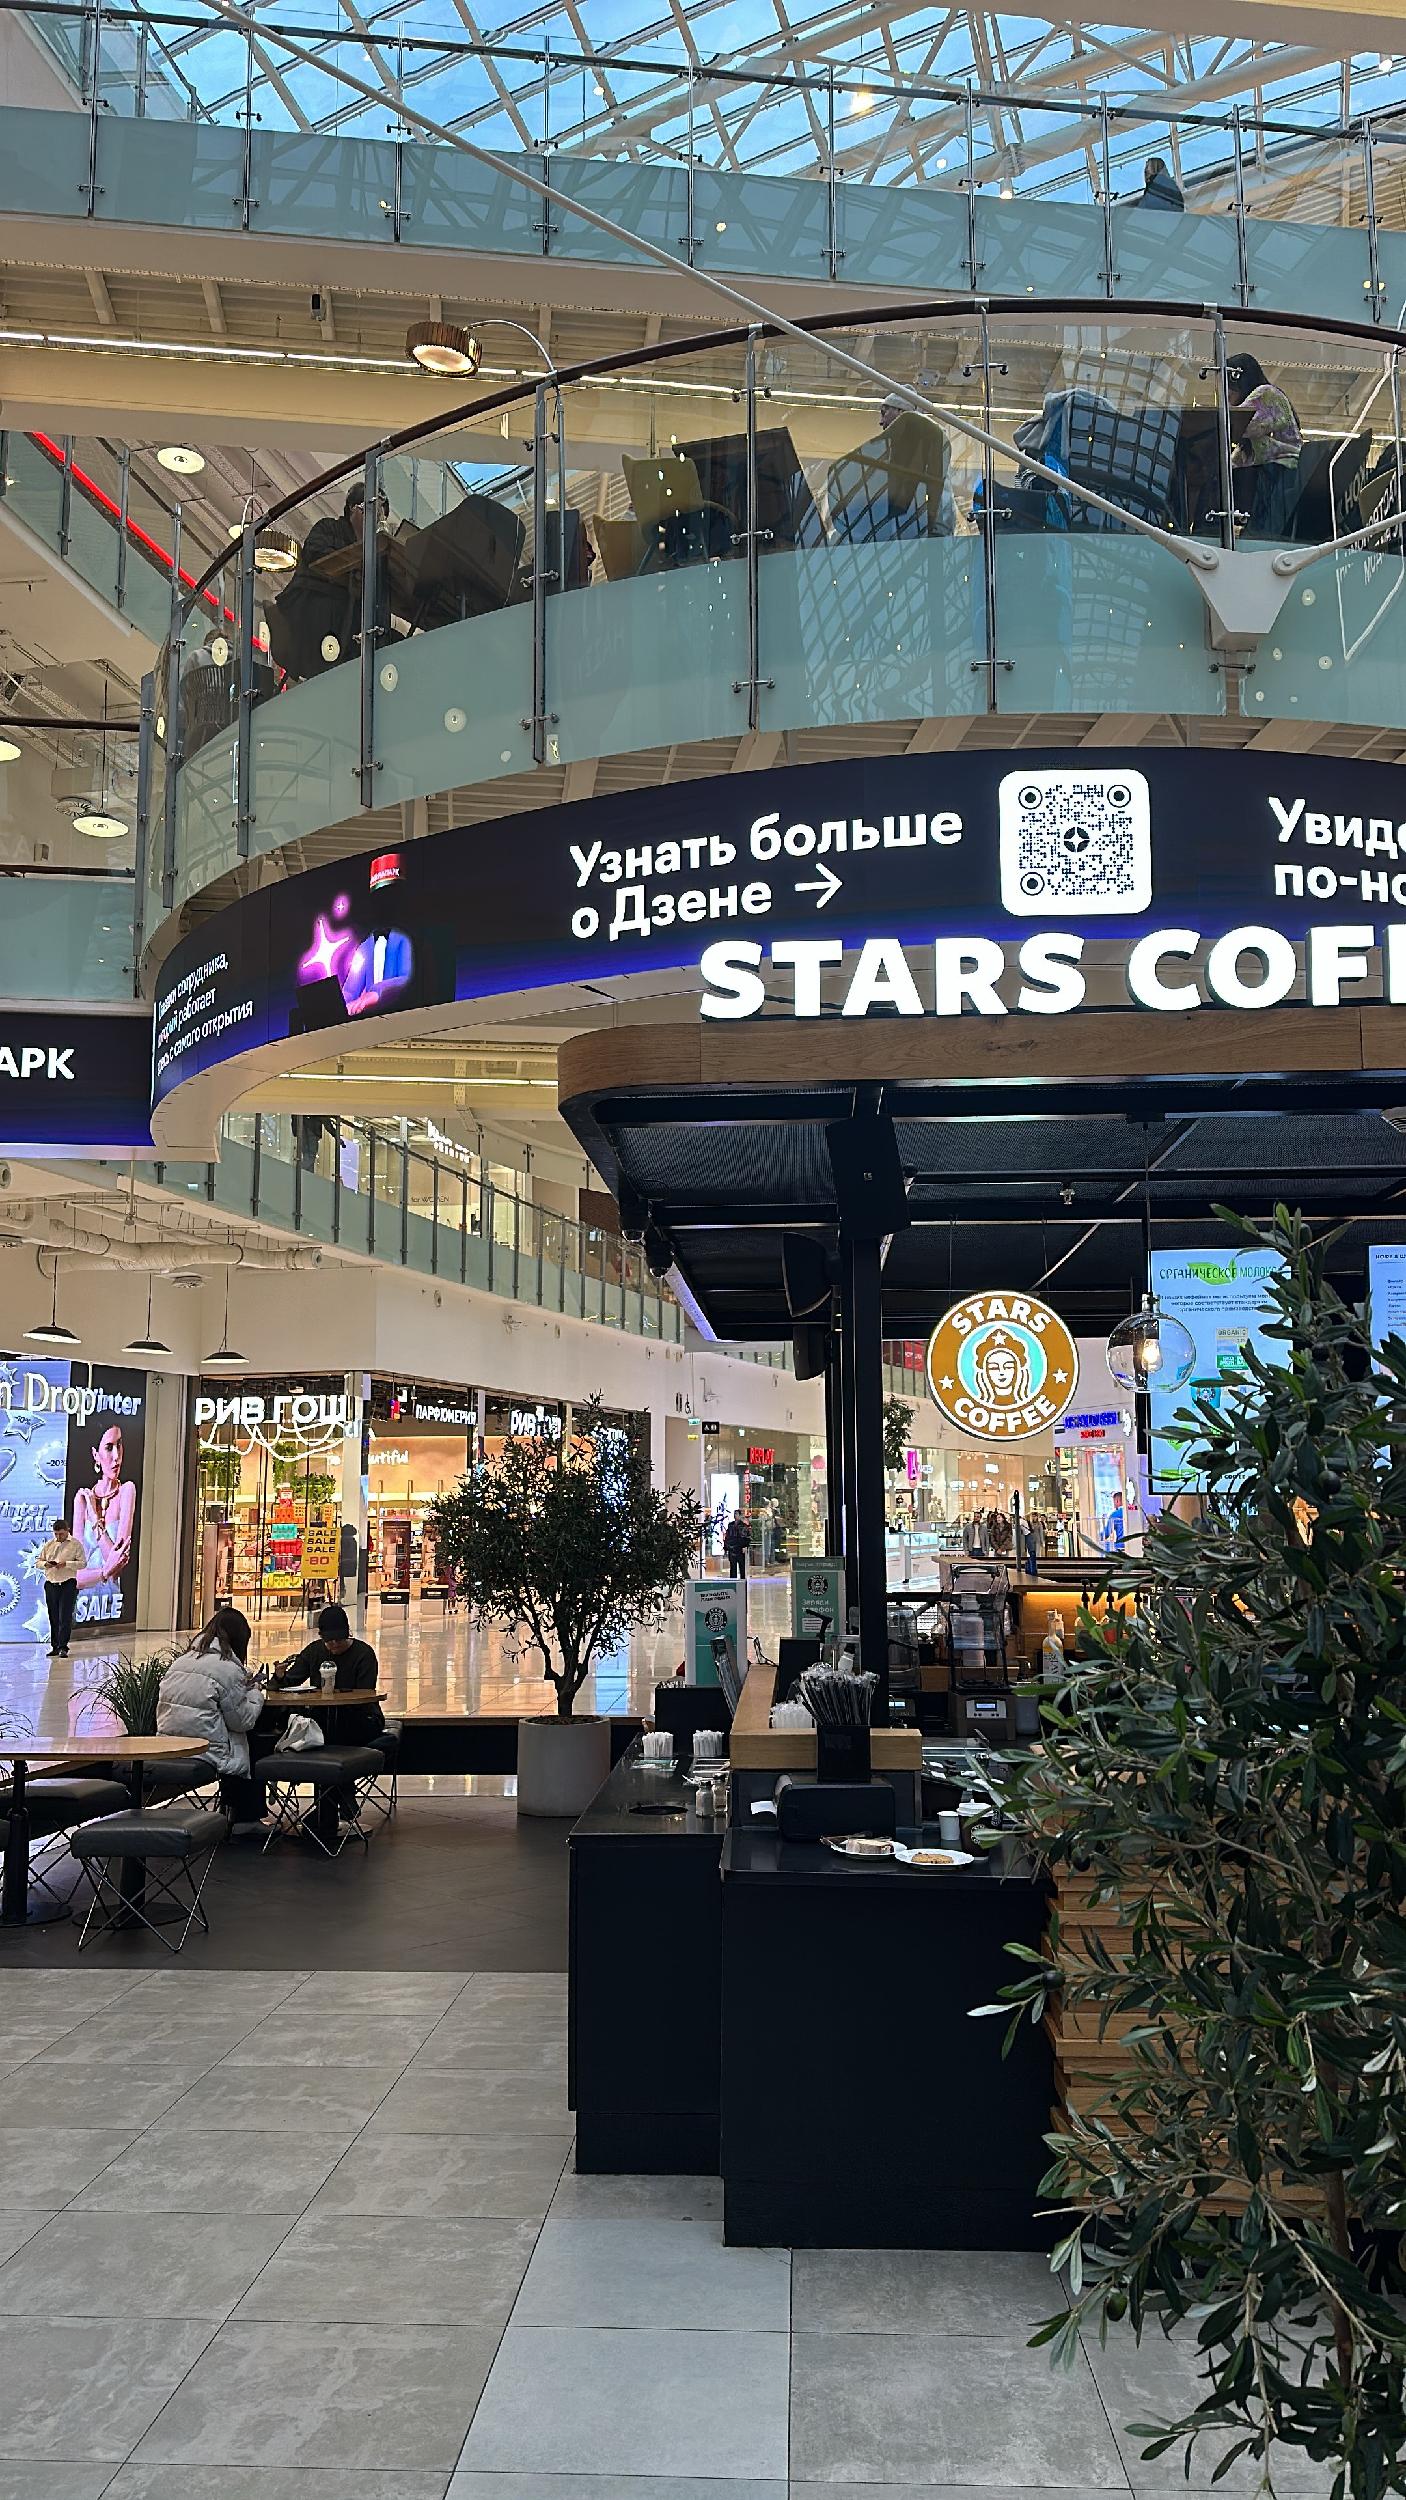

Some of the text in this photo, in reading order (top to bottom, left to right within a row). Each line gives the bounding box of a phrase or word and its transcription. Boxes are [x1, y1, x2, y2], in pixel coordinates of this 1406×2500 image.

[569, 811, 963, 888] Узнать больше
[571, 880, 773, 942] о Дзене
[700, 925, 1406, 1019] STARS COF
[178, 988, 217, 1031] работает
[201, 1000, 253, 1037] открытия
[0, 1046, 75, 1080] АРК
[1160, 1266, 1279, 1280] ОРГАНИЧЕСКОЕ МОЛОК
[951, 1298, 1051, 1335] STARS
[25, 1372, 96, 1427] Drop
[94, 1387, 142, 1416] inter
[194, 1394, 348, 1425] РИВ ГОШ
[954, 1394, 1057, 1433] COFFEE
[510, 1409, 537, 1437] РИВ
[0, 1500, 49, 1518] inter
[11, 1515, 58, 1533] SALE
[76, 1593, 124, 1623] SALE
